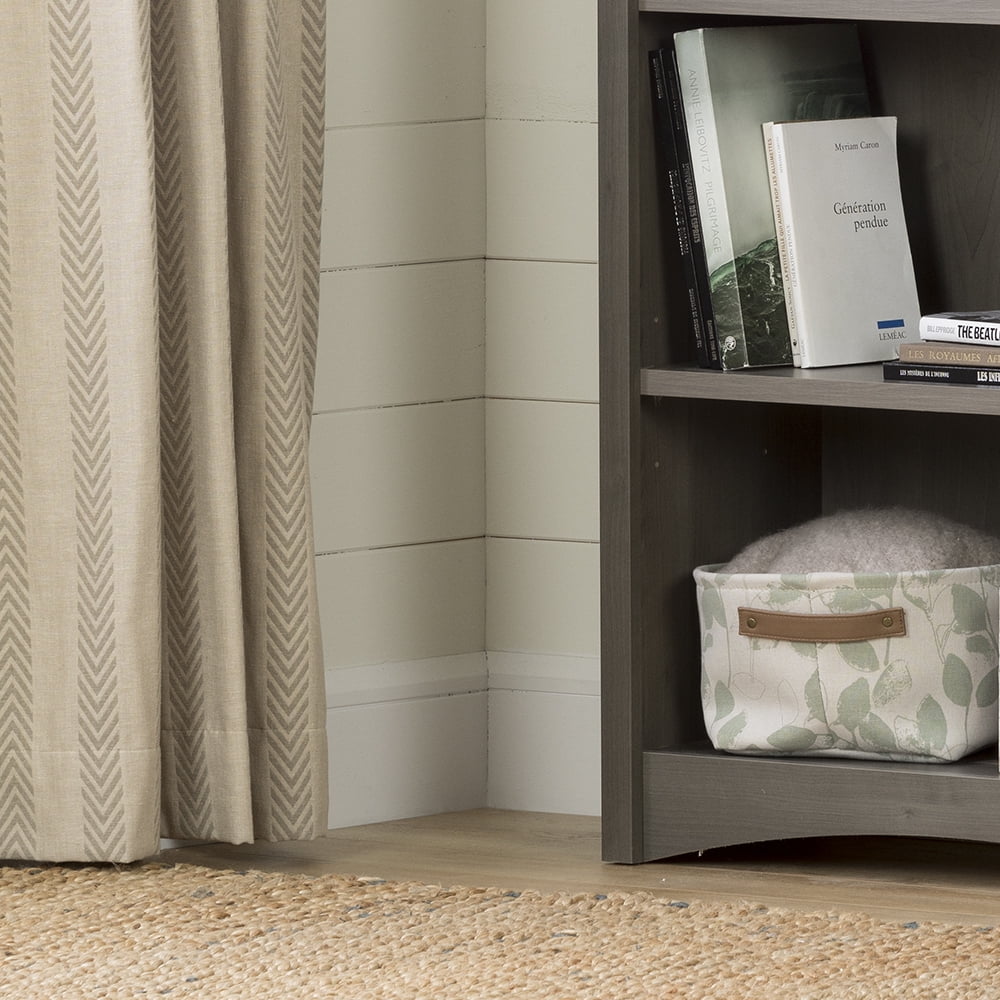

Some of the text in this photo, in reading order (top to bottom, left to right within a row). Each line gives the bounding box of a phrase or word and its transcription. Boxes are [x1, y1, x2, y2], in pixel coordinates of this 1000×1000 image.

[834, 140, 880, 153] Myriam Caron
[687, 68, 722, 254] ANNIE LEIBOVITZ PILGRIMAGE
[767, 138, 776, 174] ALLUMETTES
[833, 200, 887, 215] Génération
[853, 214, 889, 233] pendue
[878, 330, 907, 342] LEMÉAC
[957, 325, 973, 339] THE
[908, 350, 924, 359] LES
[929, 351, 981, 362] ROYAUMES
[976, 371, 988, 382] LES
